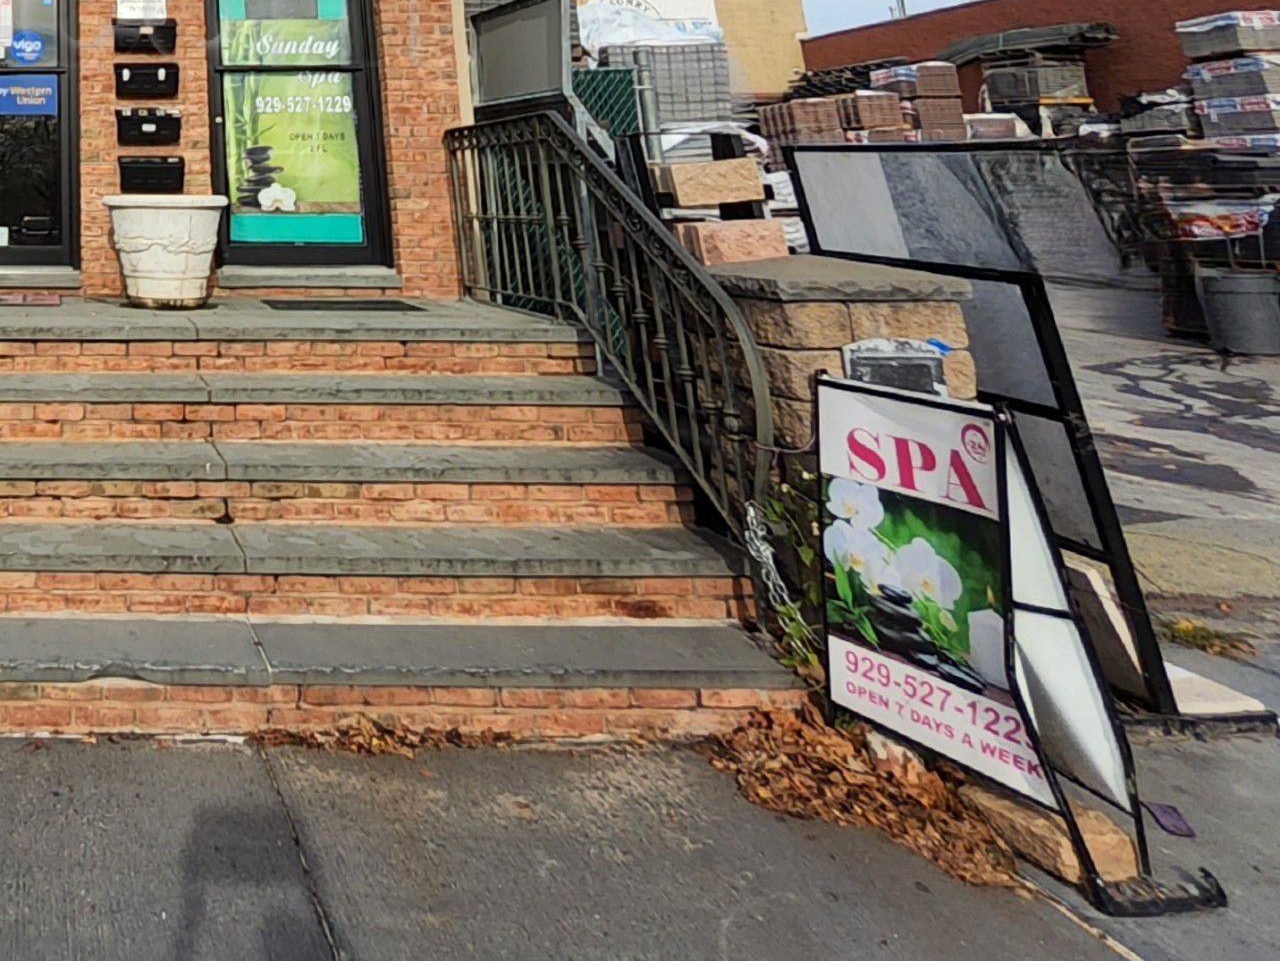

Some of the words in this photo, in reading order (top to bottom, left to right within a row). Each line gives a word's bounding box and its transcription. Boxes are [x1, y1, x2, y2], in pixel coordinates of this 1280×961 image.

[13, 39, 42, 53] vigo
[255, 35, 340, 59] Sunday
[16, 96, 46, 106] Union
[255, 95, 352, 113] 929-527-1229
[845, 426, 992, 513] SPA
[844, 649, 1036, 752] 929-527-122
[845, 680, 890, 710] OPEN
[894, 701, 905, 717] 7
[910, 709, 955, 740] DAYS
[961, 733, 975, 750] A
[979, 739, 1043, 780] WEEK
